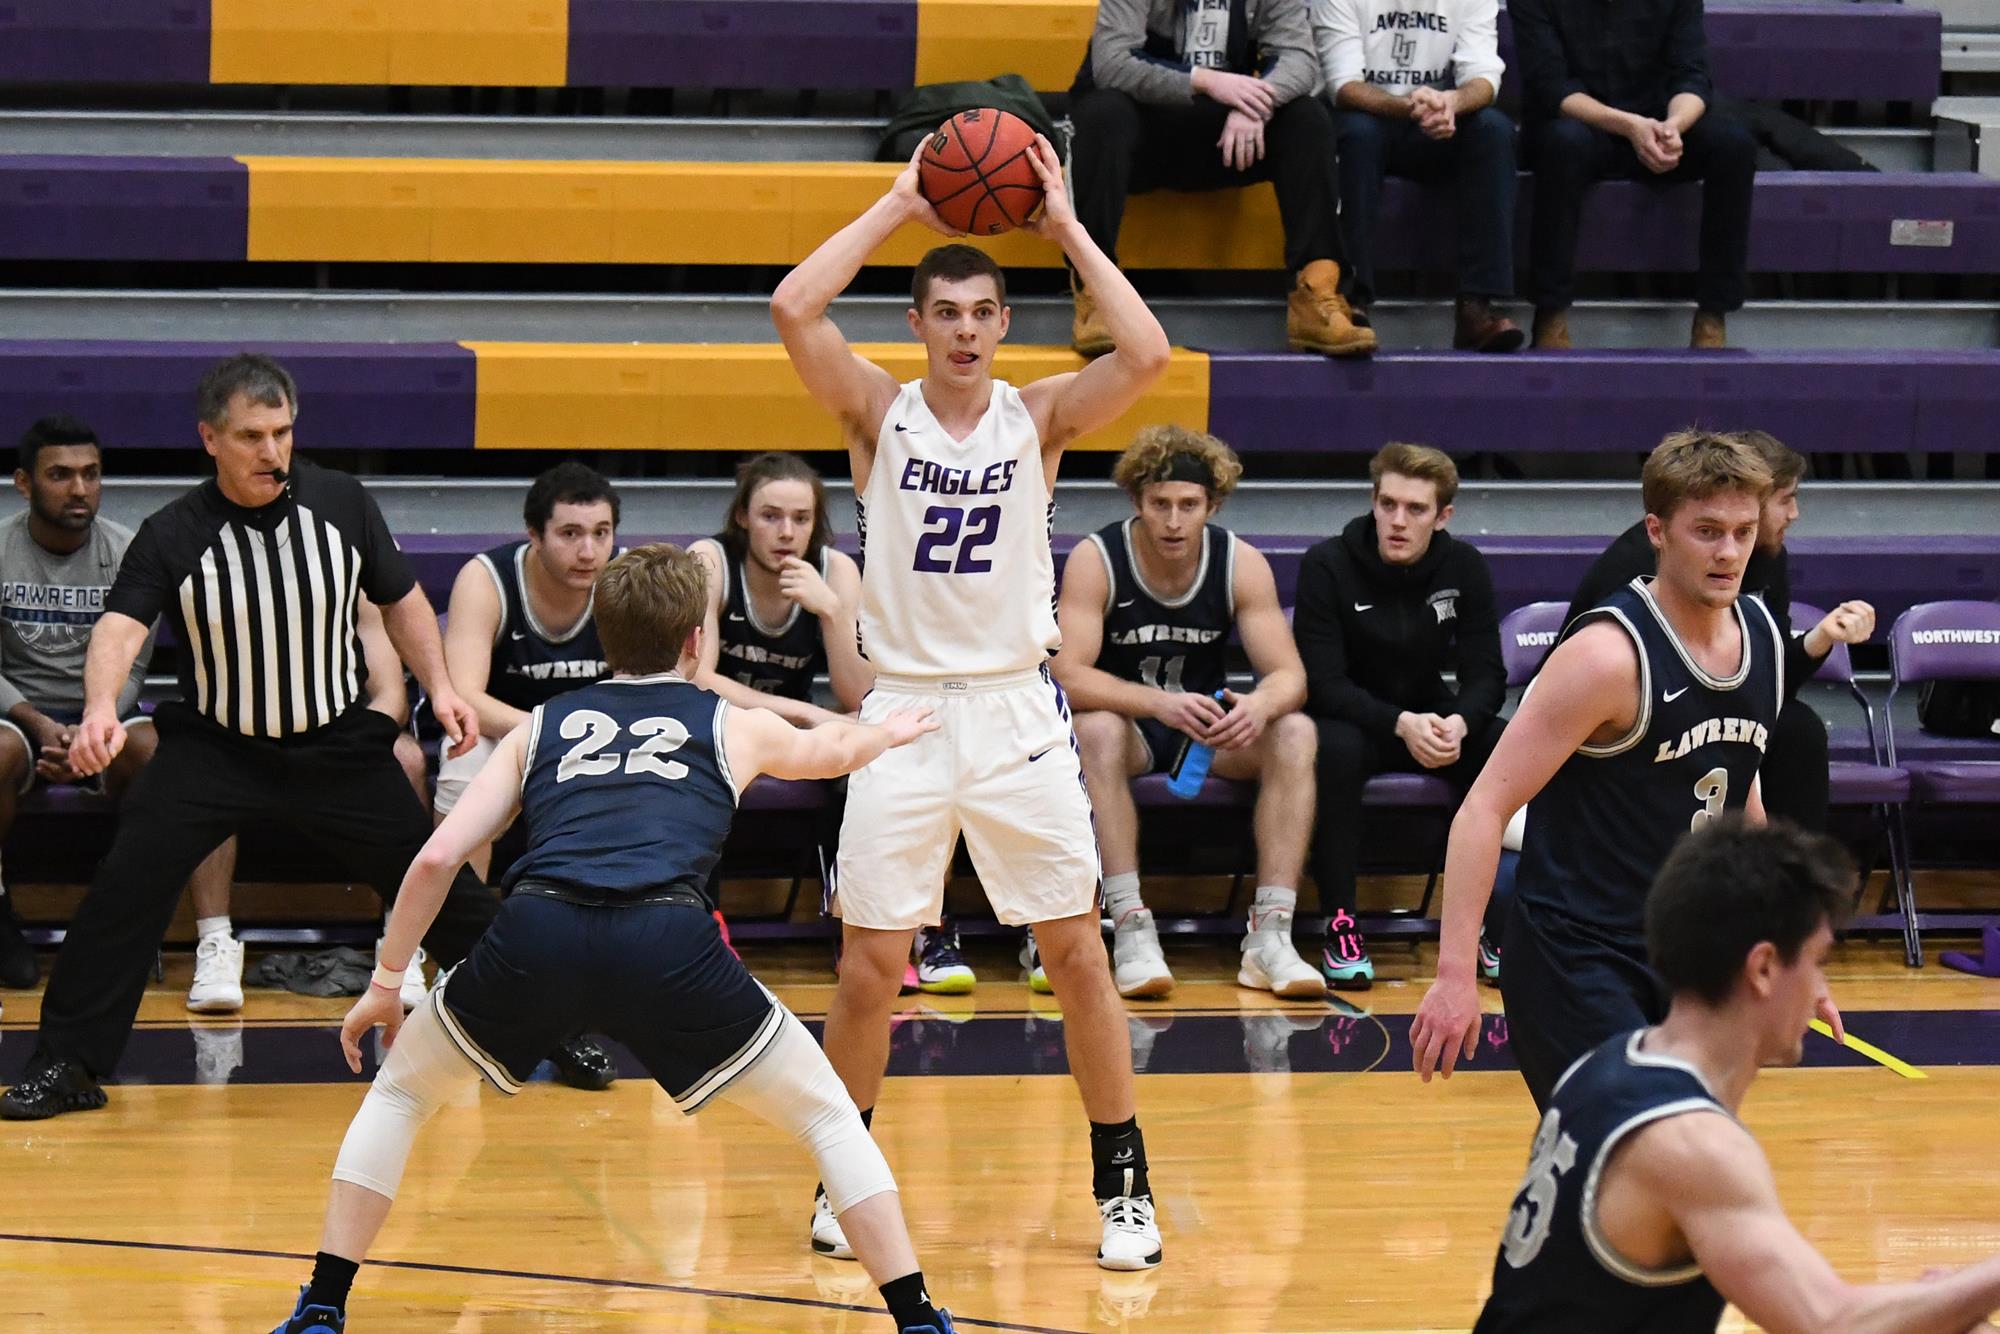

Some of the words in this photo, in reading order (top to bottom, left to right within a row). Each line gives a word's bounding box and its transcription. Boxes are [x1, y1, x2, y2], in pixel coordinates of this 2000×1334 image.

[900, 458, 1018, 495] EAGLES
[913, 505, 1001, 573] 22
[1516, 632, 1558, 646] NORT
[1138, 655, 1186, 694] 11
[556, 709, 692, 783] 22
[1654, 717, 1768, 762] LAWRENC
